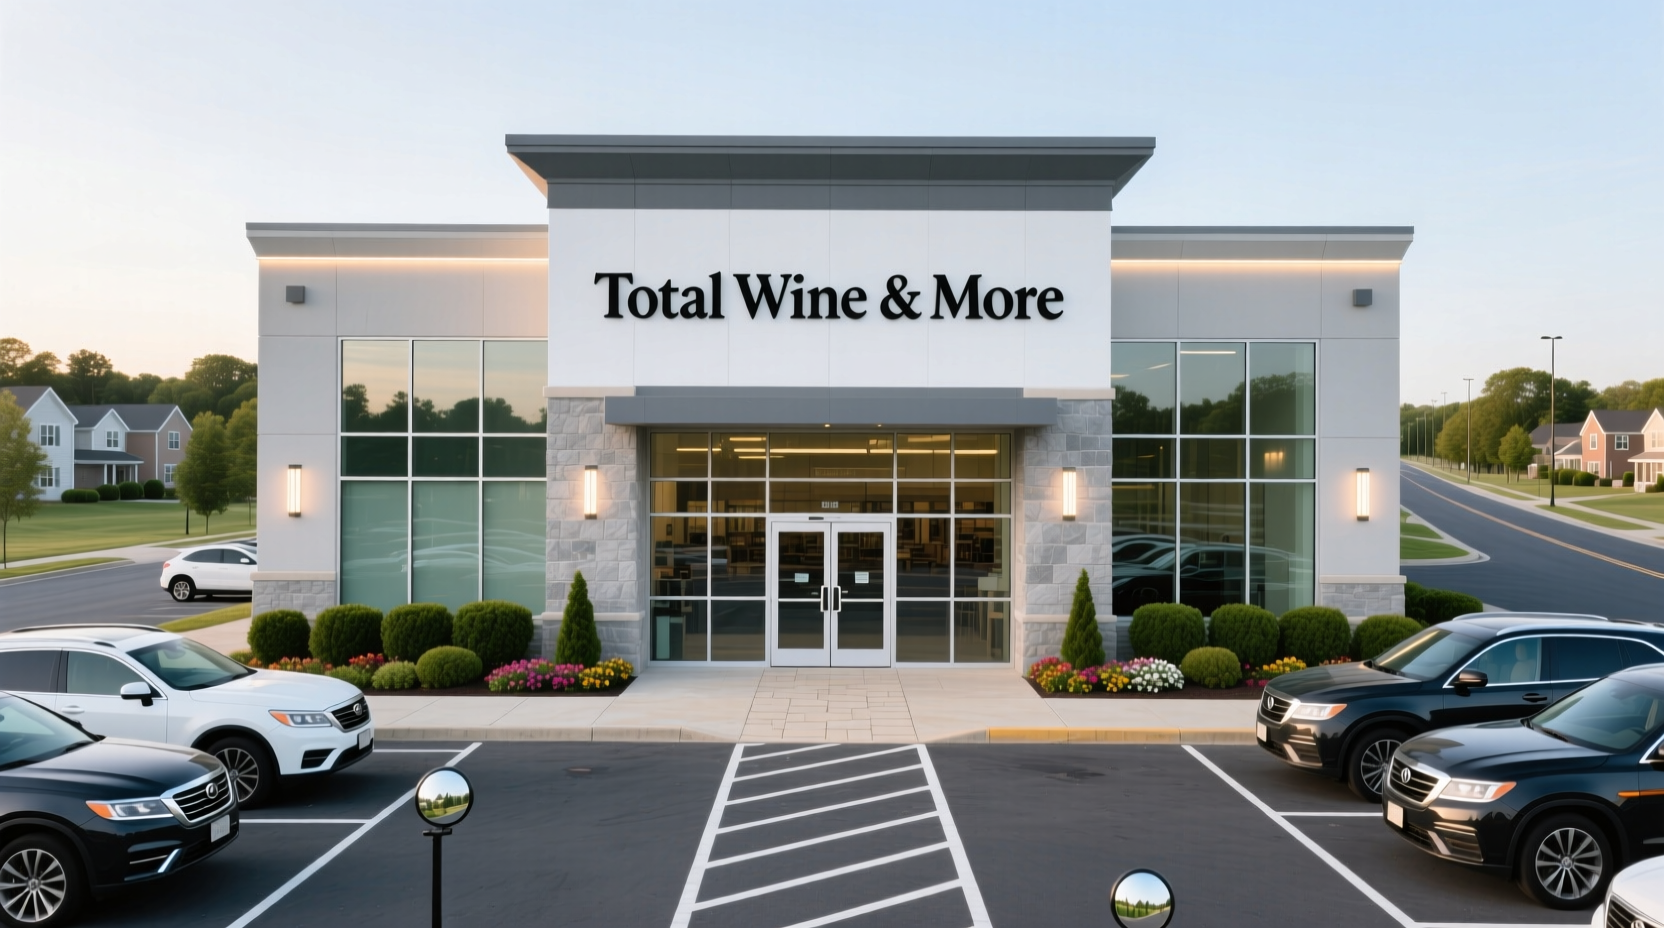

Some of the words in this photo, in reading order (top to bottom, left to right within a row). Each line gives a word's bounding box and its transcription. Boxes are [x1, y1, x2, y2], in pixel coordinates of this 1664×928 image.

[594, 271, 725, 320] Total
[733, 273, 868, 320] Wine
[879, 274, 923, 320] &
[930, 274, 1064, 320] More
